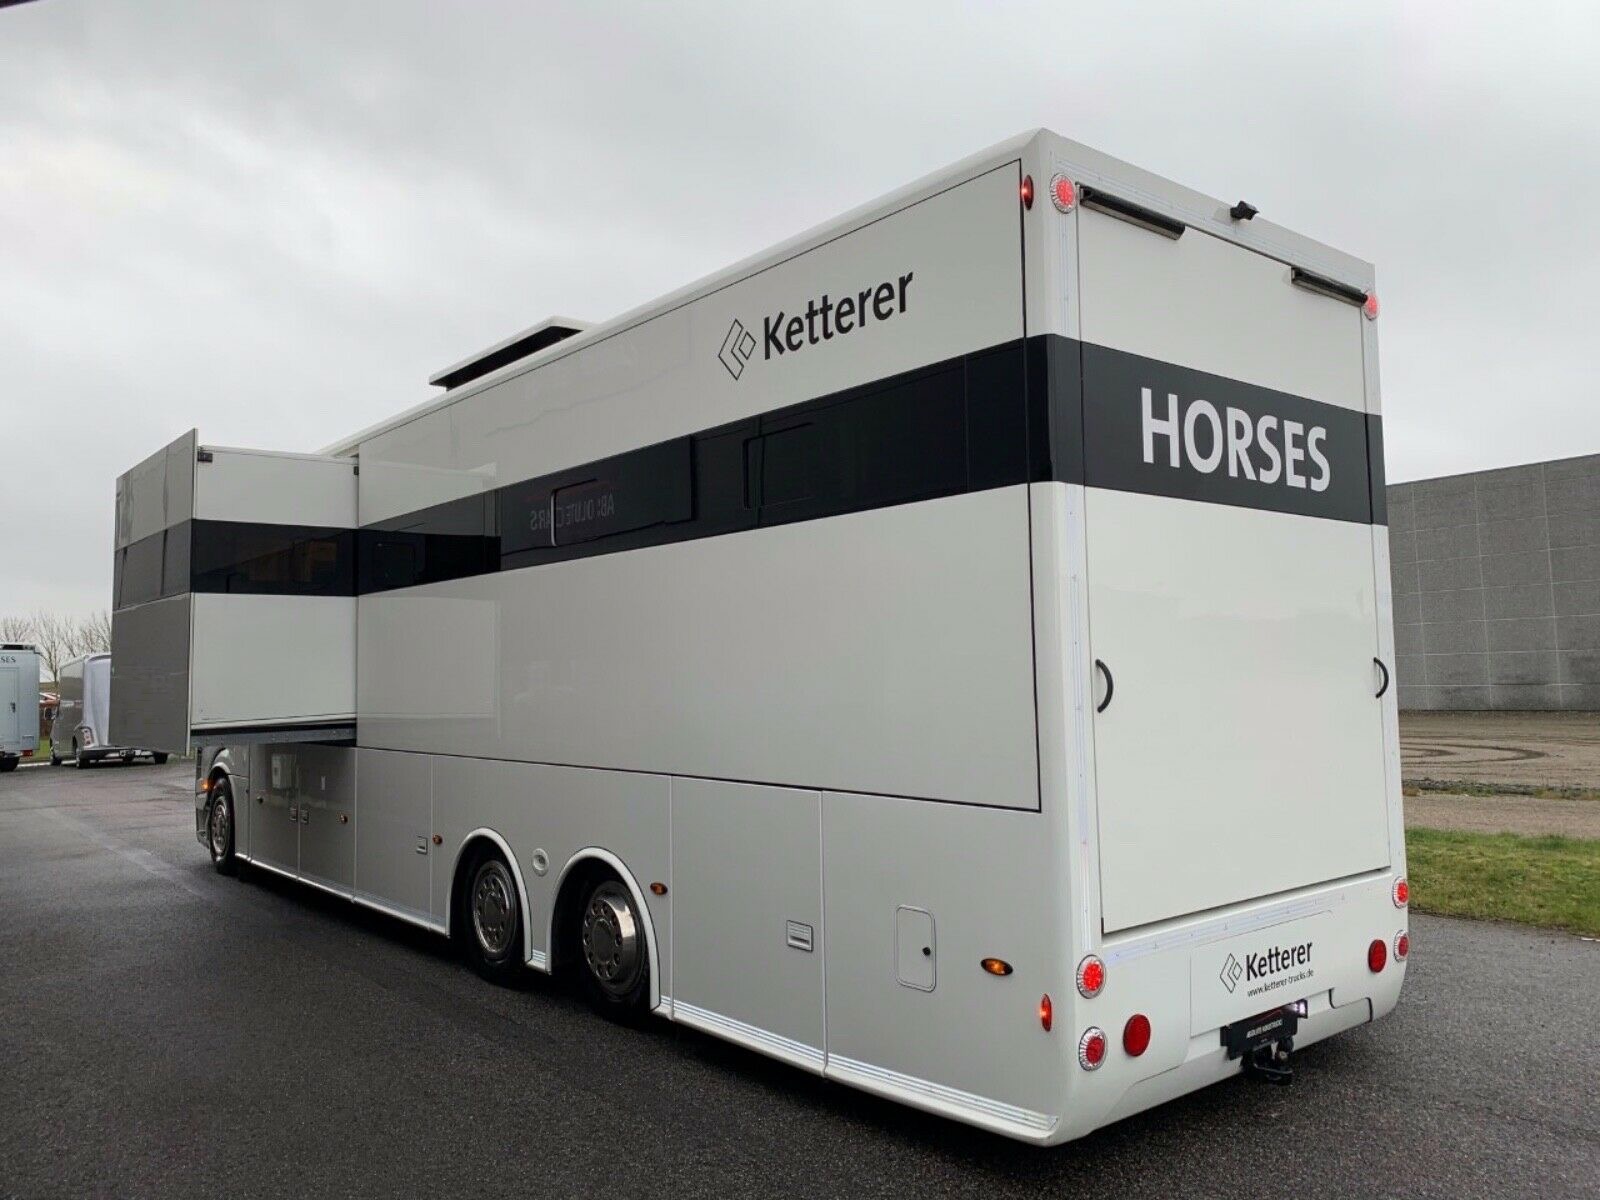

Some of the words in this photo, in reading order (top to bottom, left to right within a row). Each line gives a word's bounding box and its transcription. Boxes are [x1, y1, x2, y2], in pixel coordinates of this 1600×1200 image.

[764, 272, 914, 360] Ketterer
[1141, 387, 1330, 492] HORSES
[1246, 942, 1313, 982] Ketterer
[1247, 968, 1314, 997] www.ketterer-trucks.de
